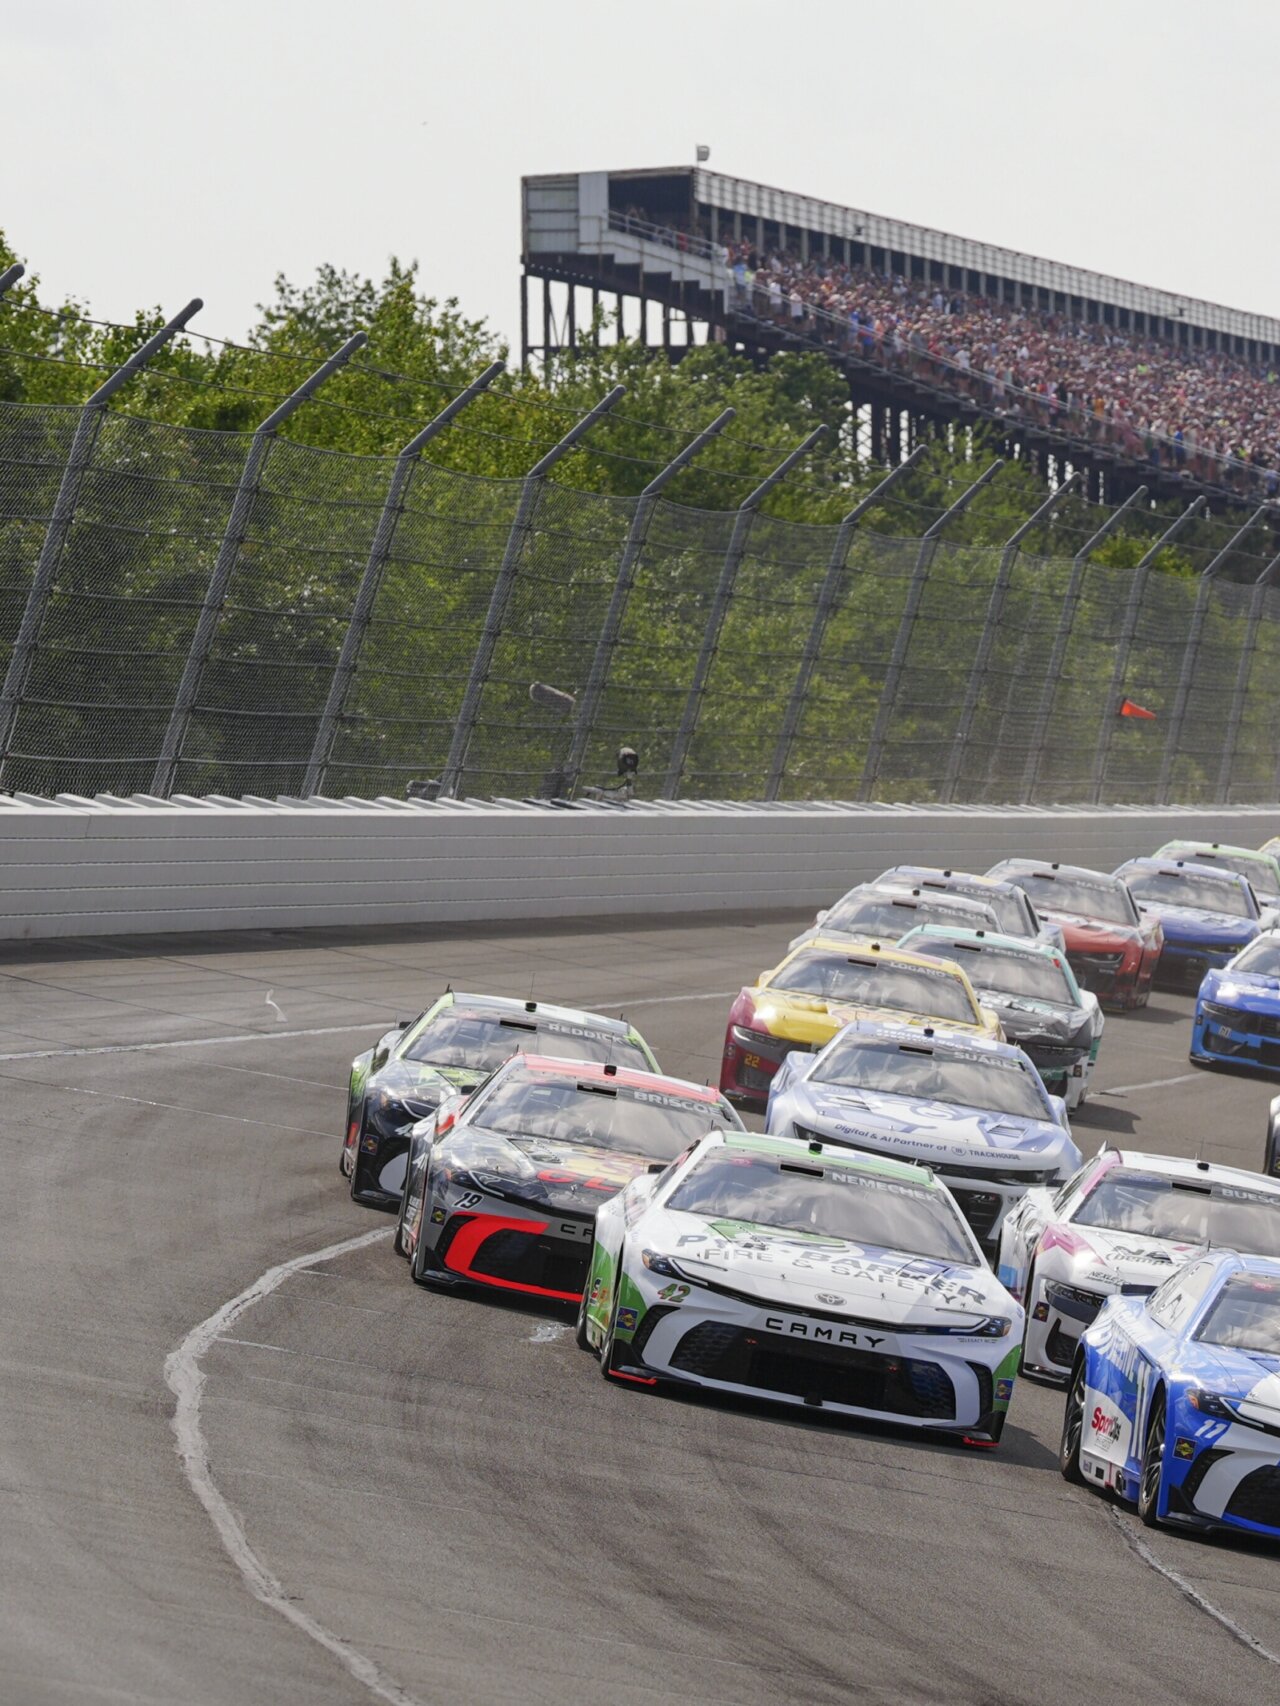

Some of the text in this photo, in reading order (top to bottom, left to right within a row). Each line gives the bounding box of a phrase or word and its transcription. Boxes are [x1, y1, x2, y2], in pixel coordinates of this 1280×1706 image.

[889, 961, 946, 979] LOGANO
[547, 1023, 625, 1045] REDDICK
[744, 1053, 761, 1069] 22
[633, 1090, 722, 1116] BRISCOE
[834, 1123, 868, 1141] Digital
[892, 1137, 934, 1151] Partner
[968, 1150, 1021, 1161] TRACKHOUSE
[831, 1172, 938, 1202] NEMECHEK
[453, 1190, 484, 1210] 19
[703, 1248, 775, 1263] FIRE
[830, 1265, 959, 1305] SAFETY
[657, 1283, 692, 1303] 42
[765, 1316, 886, 1348] CAMRY
[1194, 1419, 1228, 1439] 11
